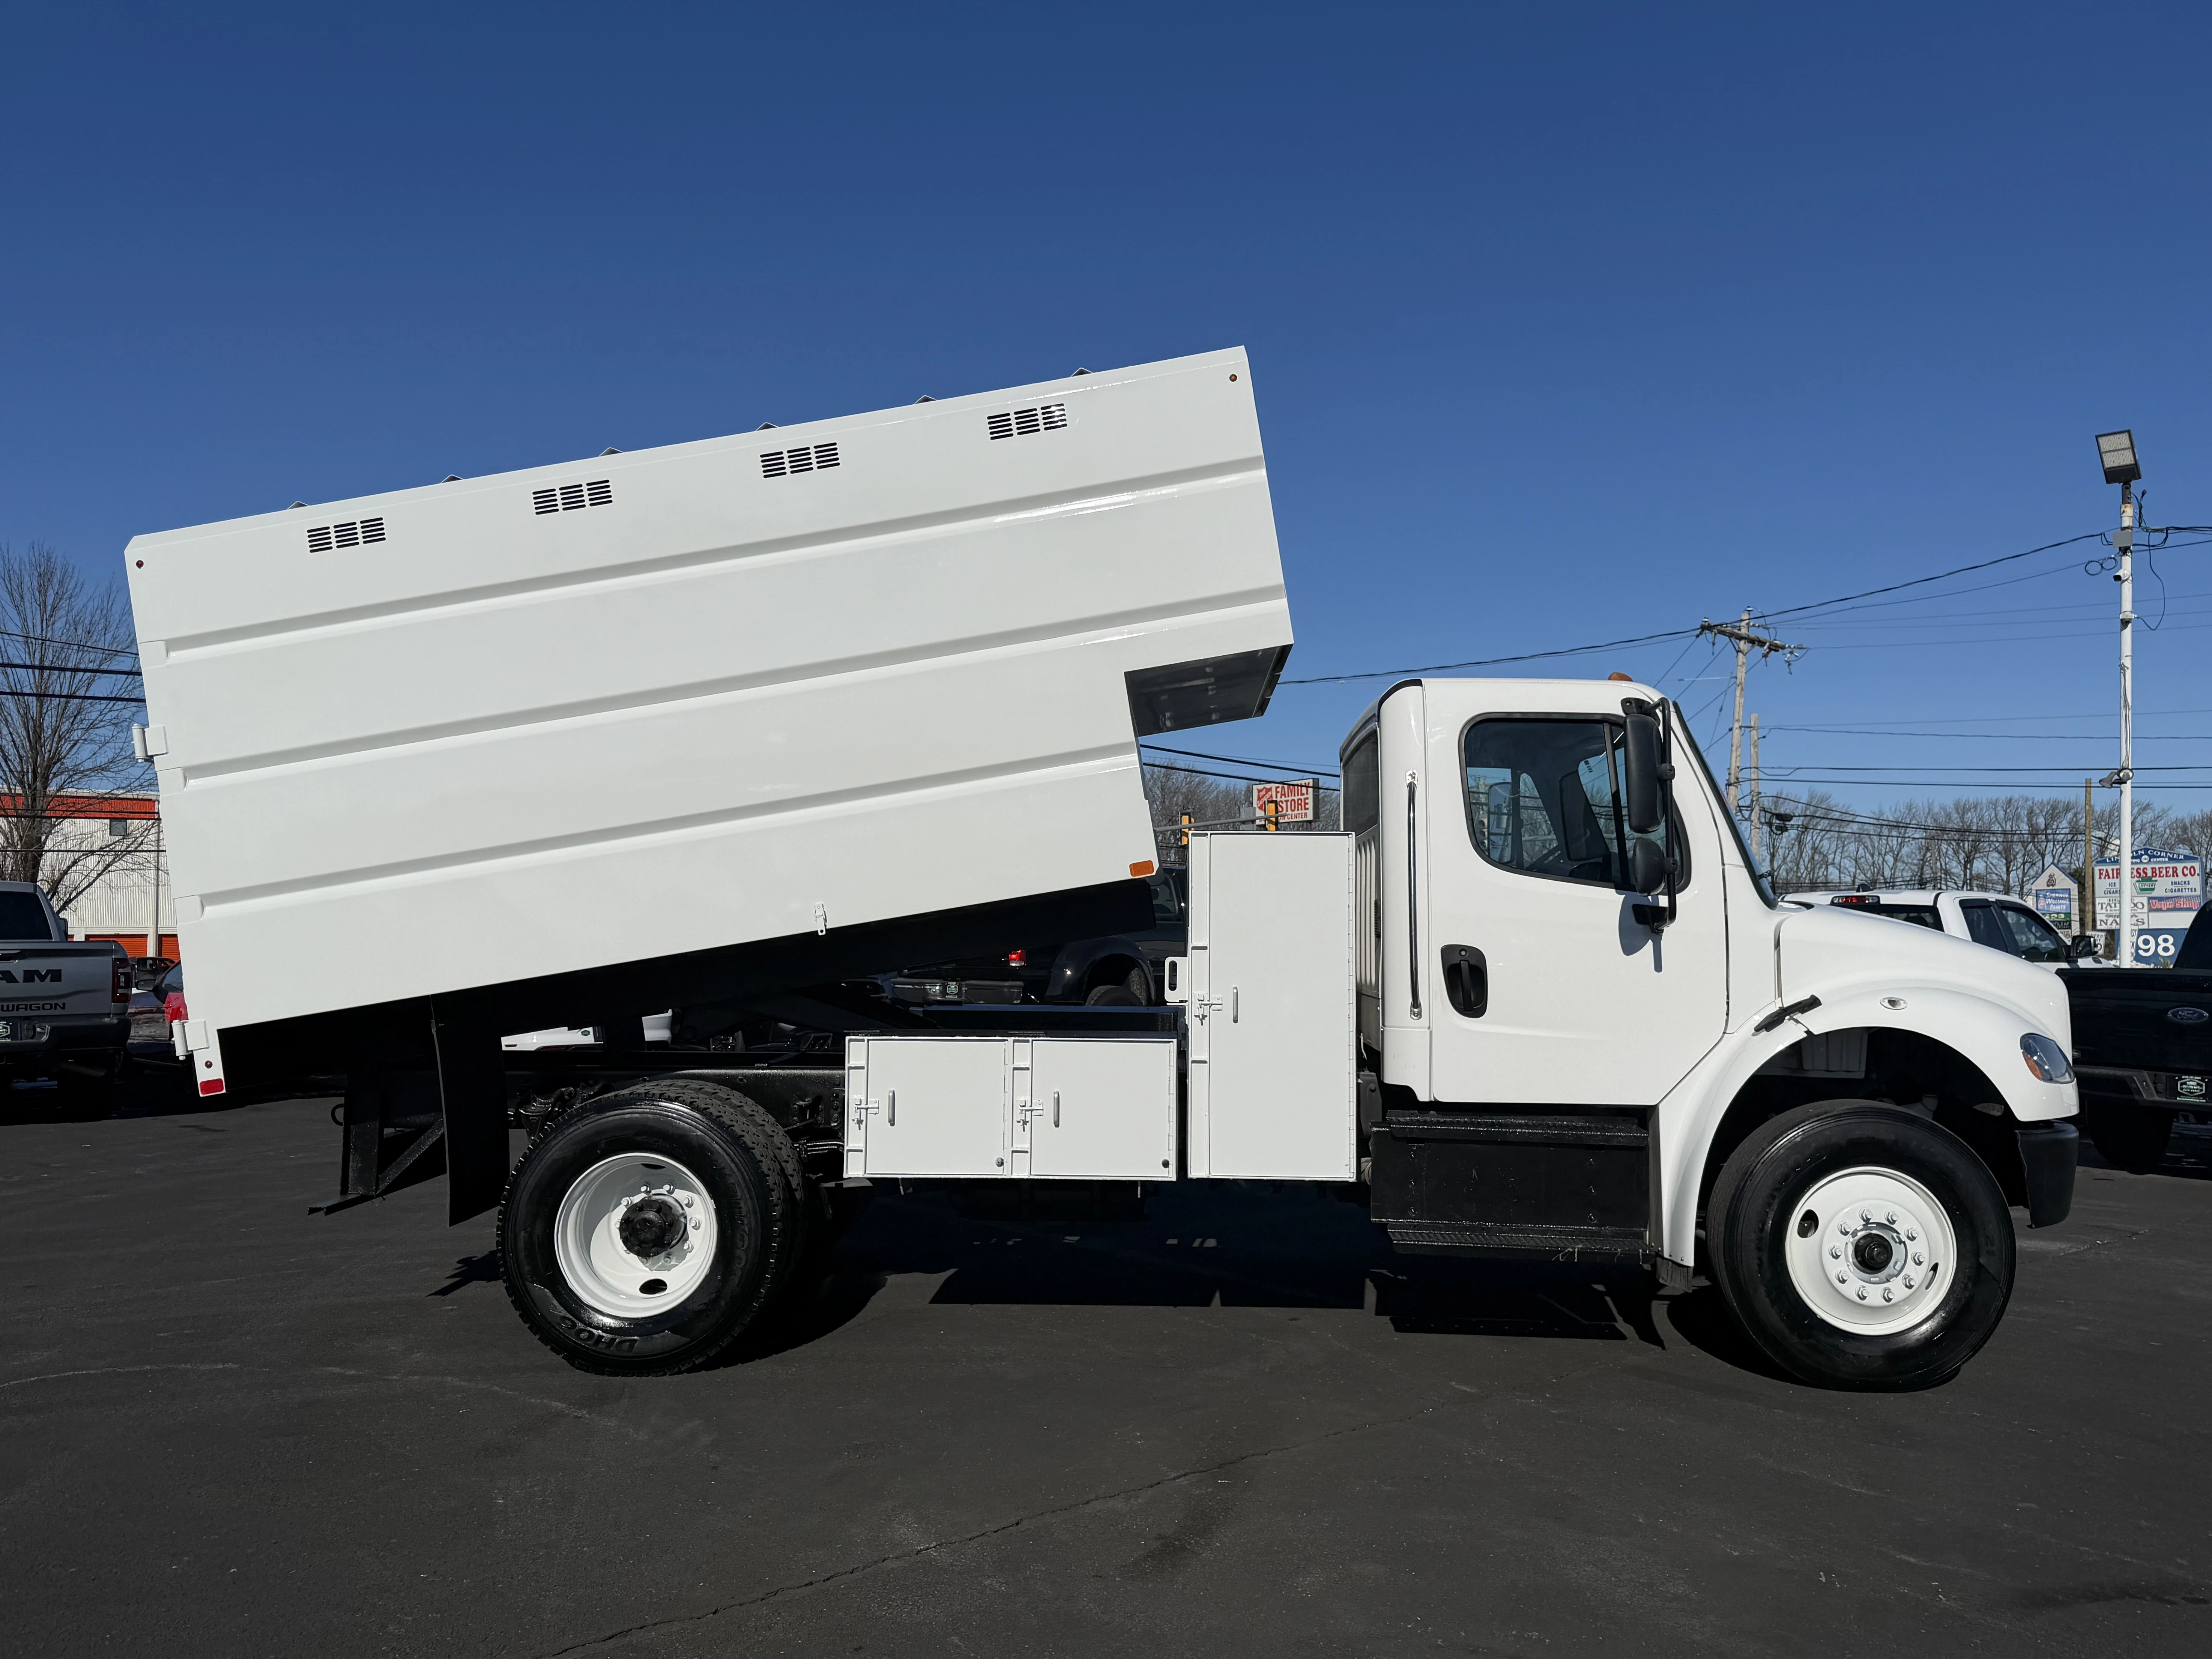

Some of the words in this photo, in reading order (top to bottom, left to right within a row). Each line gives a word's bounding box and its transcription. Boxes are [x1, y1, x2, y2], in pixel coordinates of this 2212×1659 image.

[1275, 782, 1310, 799] FAMILY
[1278, 797, 1309, 813] STORE
[2148, 850, 2184, 860] CORNER
[2098, 867, 2148, 879] FAIRESS
[2150, 866, 2179, 878] BEER
[2181, 866, 2200, 877] CO.
[2176, 898, 2200, 910] Shop
[2138, 934, 2175, 957] 98
[0, 969, 62, 983] AM
[0, 1002, 66, 1012] WAGON
